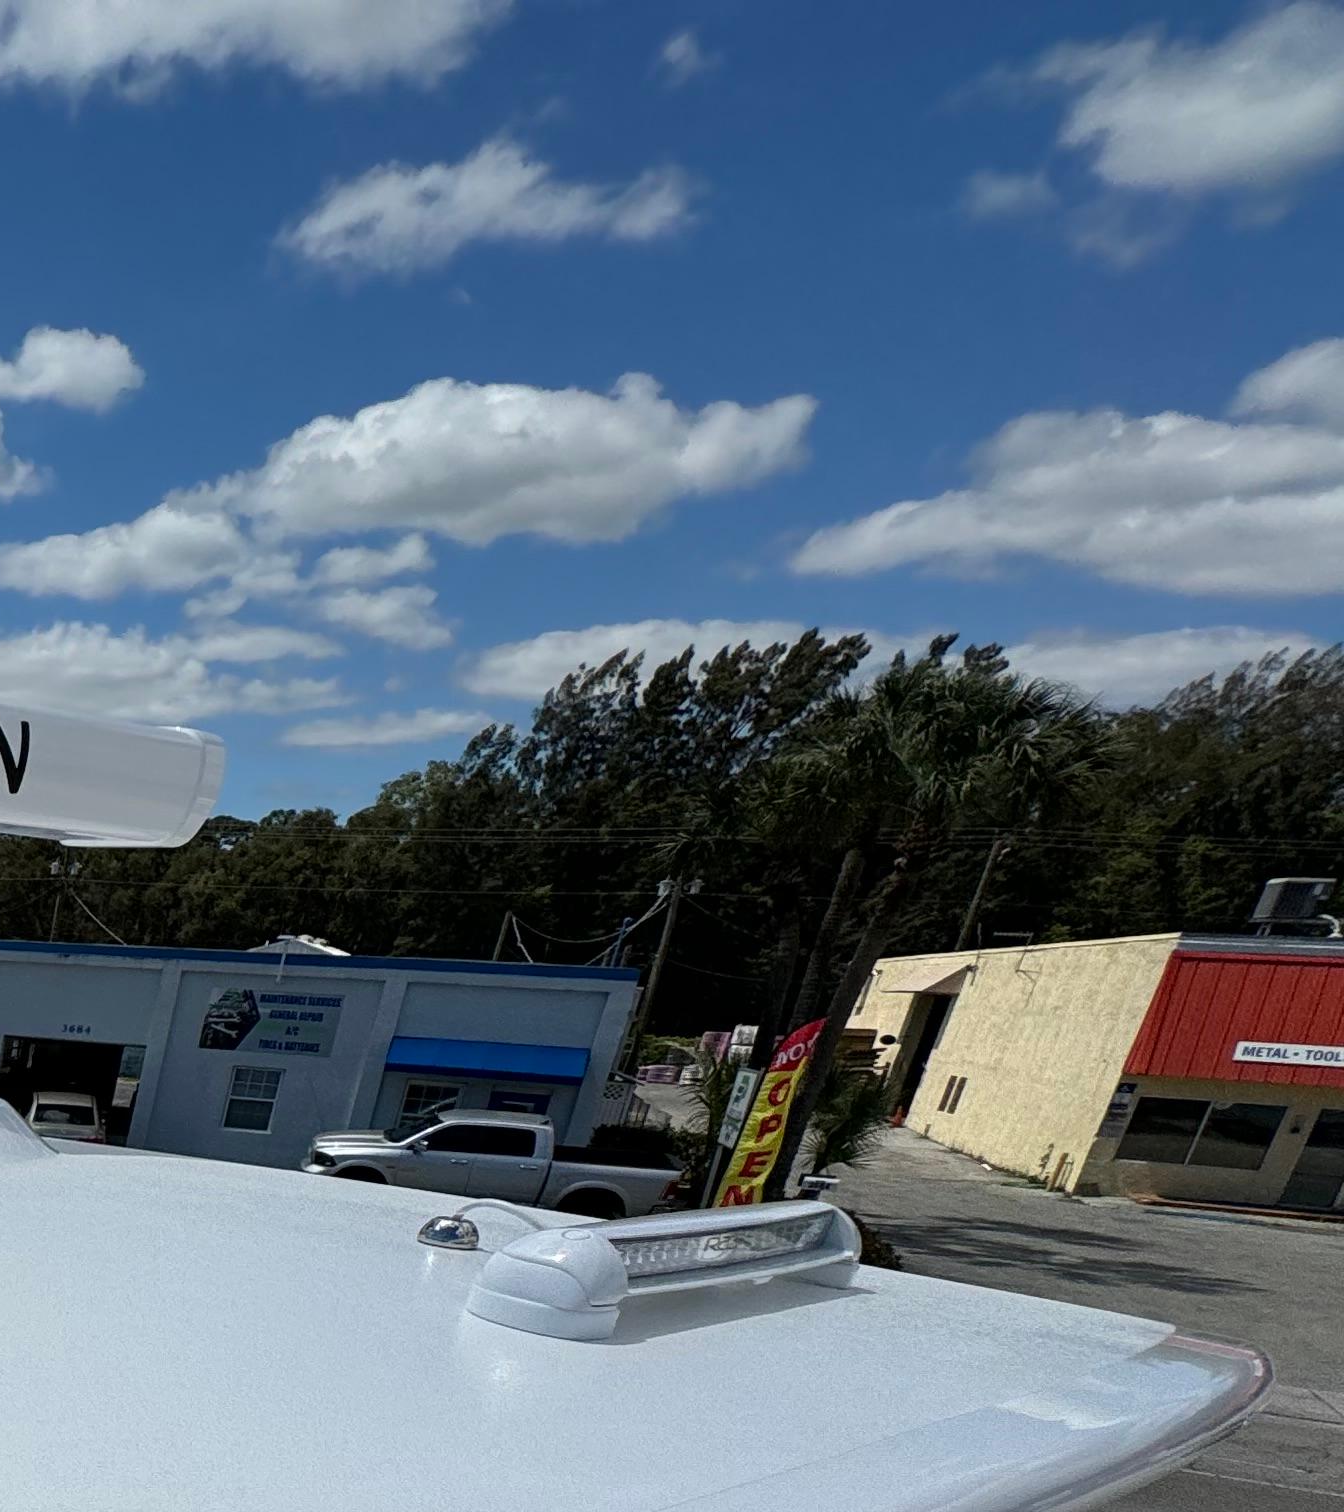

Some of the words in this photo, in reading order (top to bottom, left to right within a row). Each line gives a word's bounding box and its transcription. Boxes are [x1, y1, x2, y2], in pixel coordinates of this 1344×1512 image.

[1241, 1045, 1291, 1060] METAL
[1305, 1049, 1344, 1062] TOOL
[719, 1076, 792, 1208] OPEN
